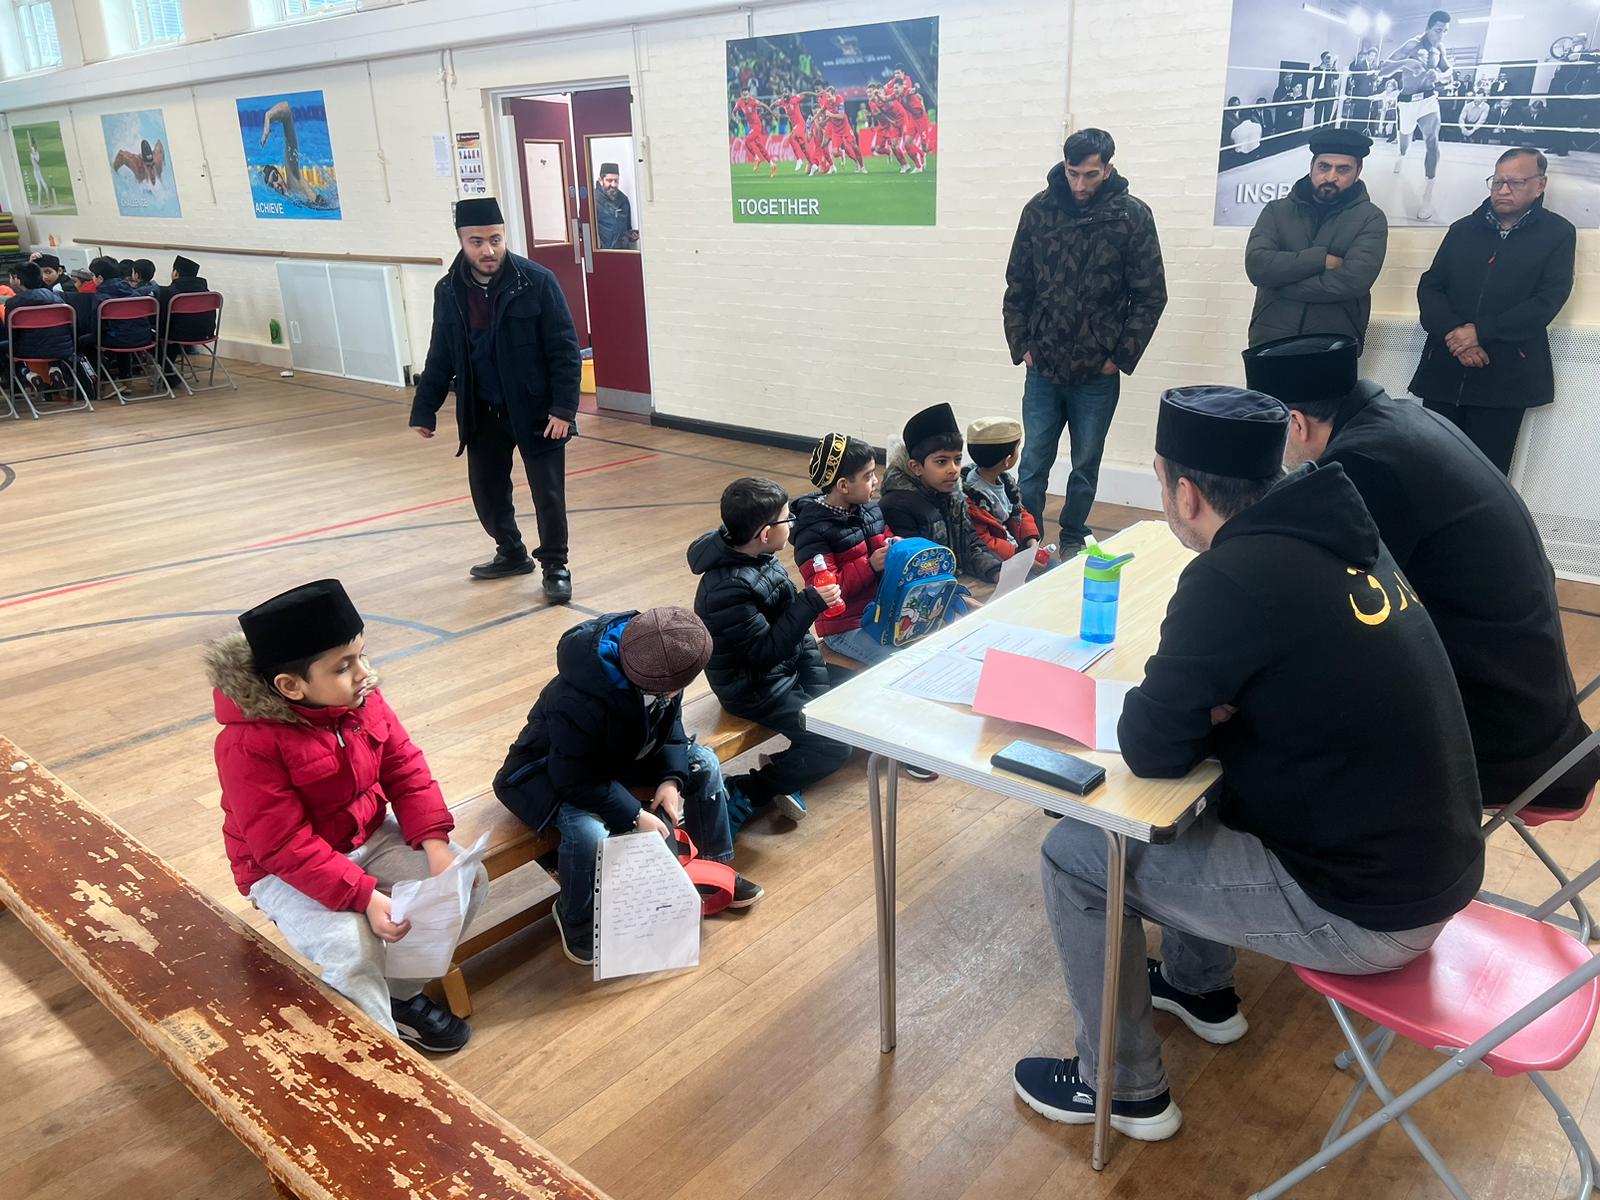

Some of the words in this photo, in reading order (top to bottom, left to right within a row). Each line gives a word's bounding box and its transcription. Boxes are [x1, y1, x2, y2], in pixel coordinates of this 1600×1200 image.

[1236, 182, 1292, 203] INSP
[255, 202, 285, 214] ACHIEVE
[738, 198, 820, 215] TOGETHER
